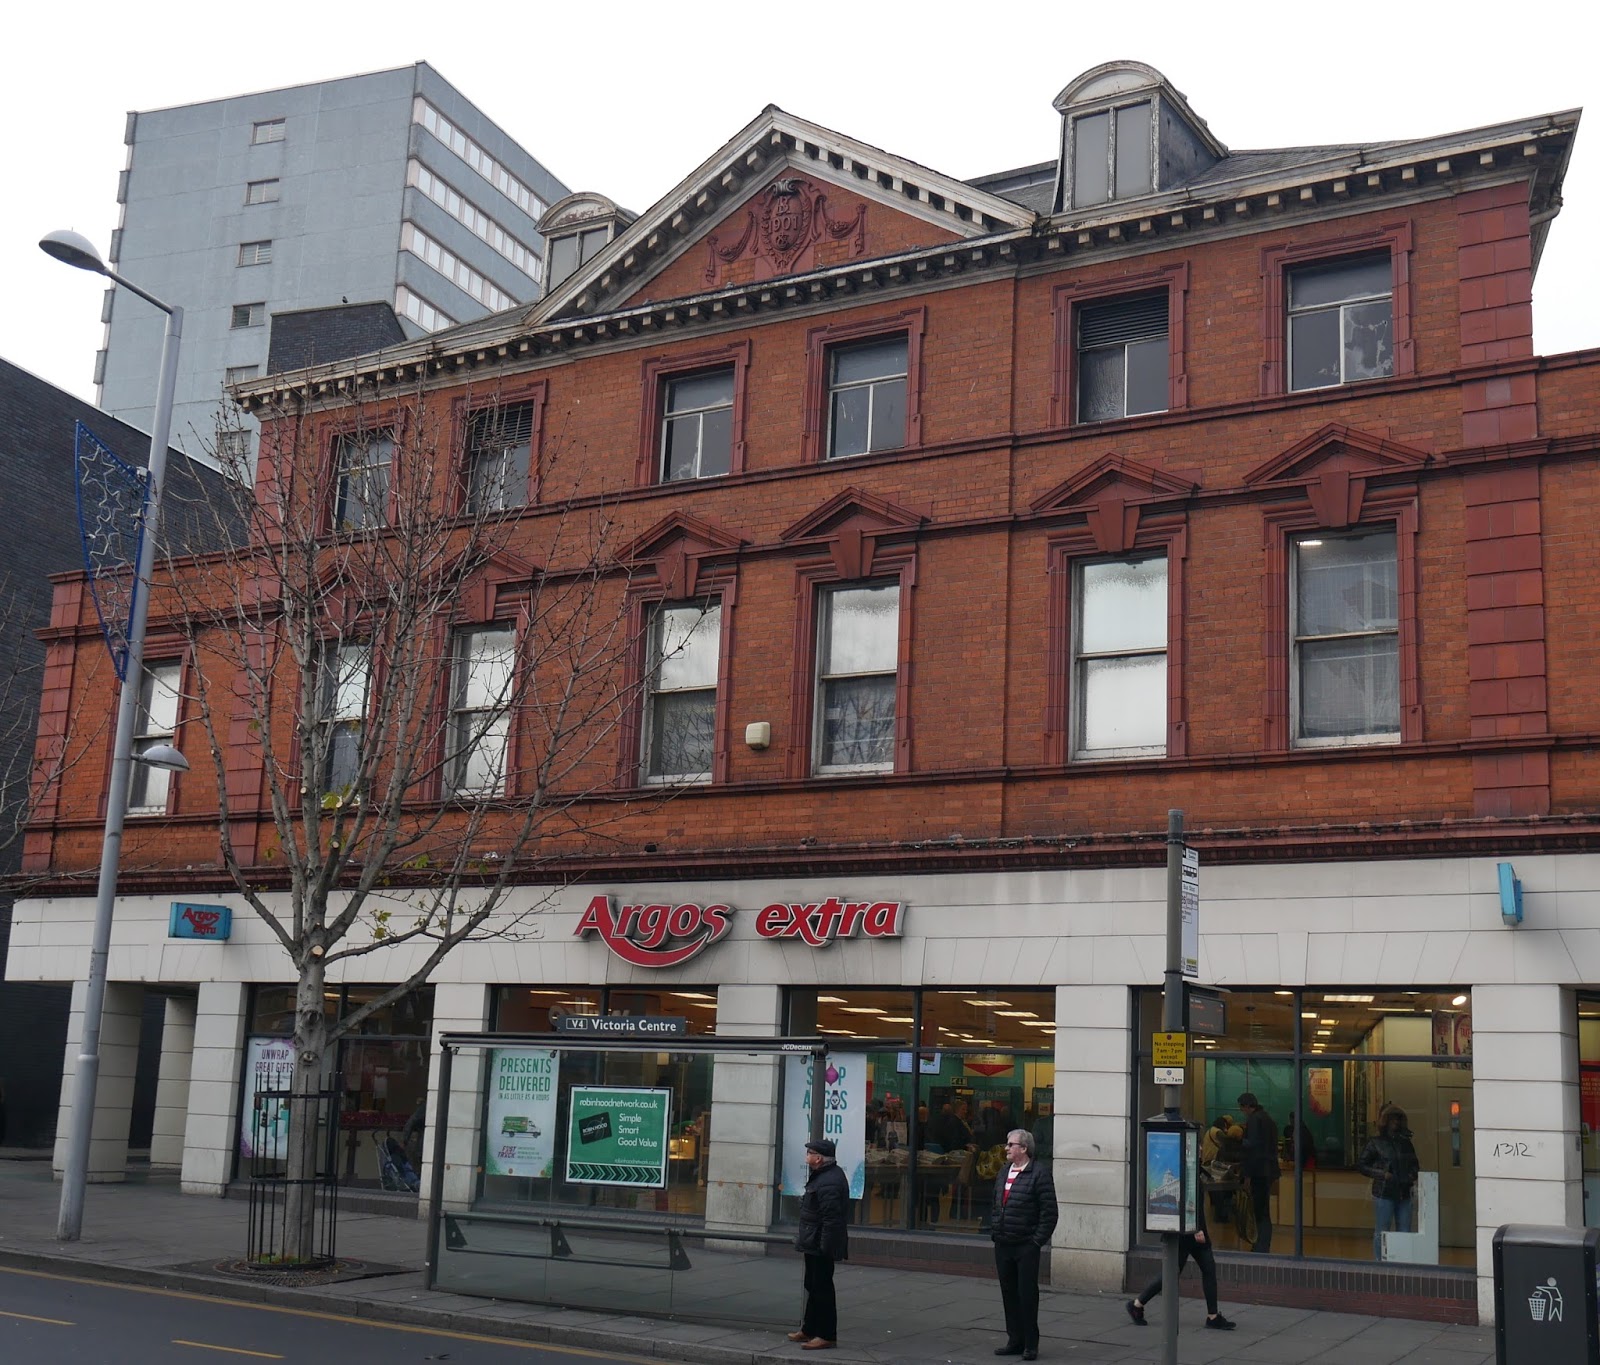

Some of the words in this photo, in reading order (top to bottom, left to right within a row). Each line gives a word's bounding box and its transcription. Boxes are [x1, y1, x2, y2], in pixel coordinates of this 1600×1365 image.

[768, 216, 797, 234] 1901
[573, 895, 733, 968] Argos
[755, 897, 901, 947] extra
[572, 1019, 583, 1028] V4
[592, 1019, 635, 1031] Victoria
[639, 1020, 676, 1031] Centre
[262, 1049, 289, 1060] UNWRAP
[255, 1062, 274, 1073] GREAT
[276, 1062, 294, 1073] GIFTS
[500, 1057, 551, 1074] PRESENTS
[806, 1066, 846, 1086] SP
[499, 1076, 550, 1092] DELIVERED
[579, 1098, 658, 1109] robinhoodnetwork.co.uk
[803, 1089, 847, 1110] AGS
[619, 1113, 641, 1124] Simple
[807, 1114, 842, 1134] YUR
[618, 1125, 639, 1134] Smart
[618, 1137, 638, 1146] Good
[639, 1138, 657, 1147] Value
[1493, 1142, 1536, 1157] 1312
